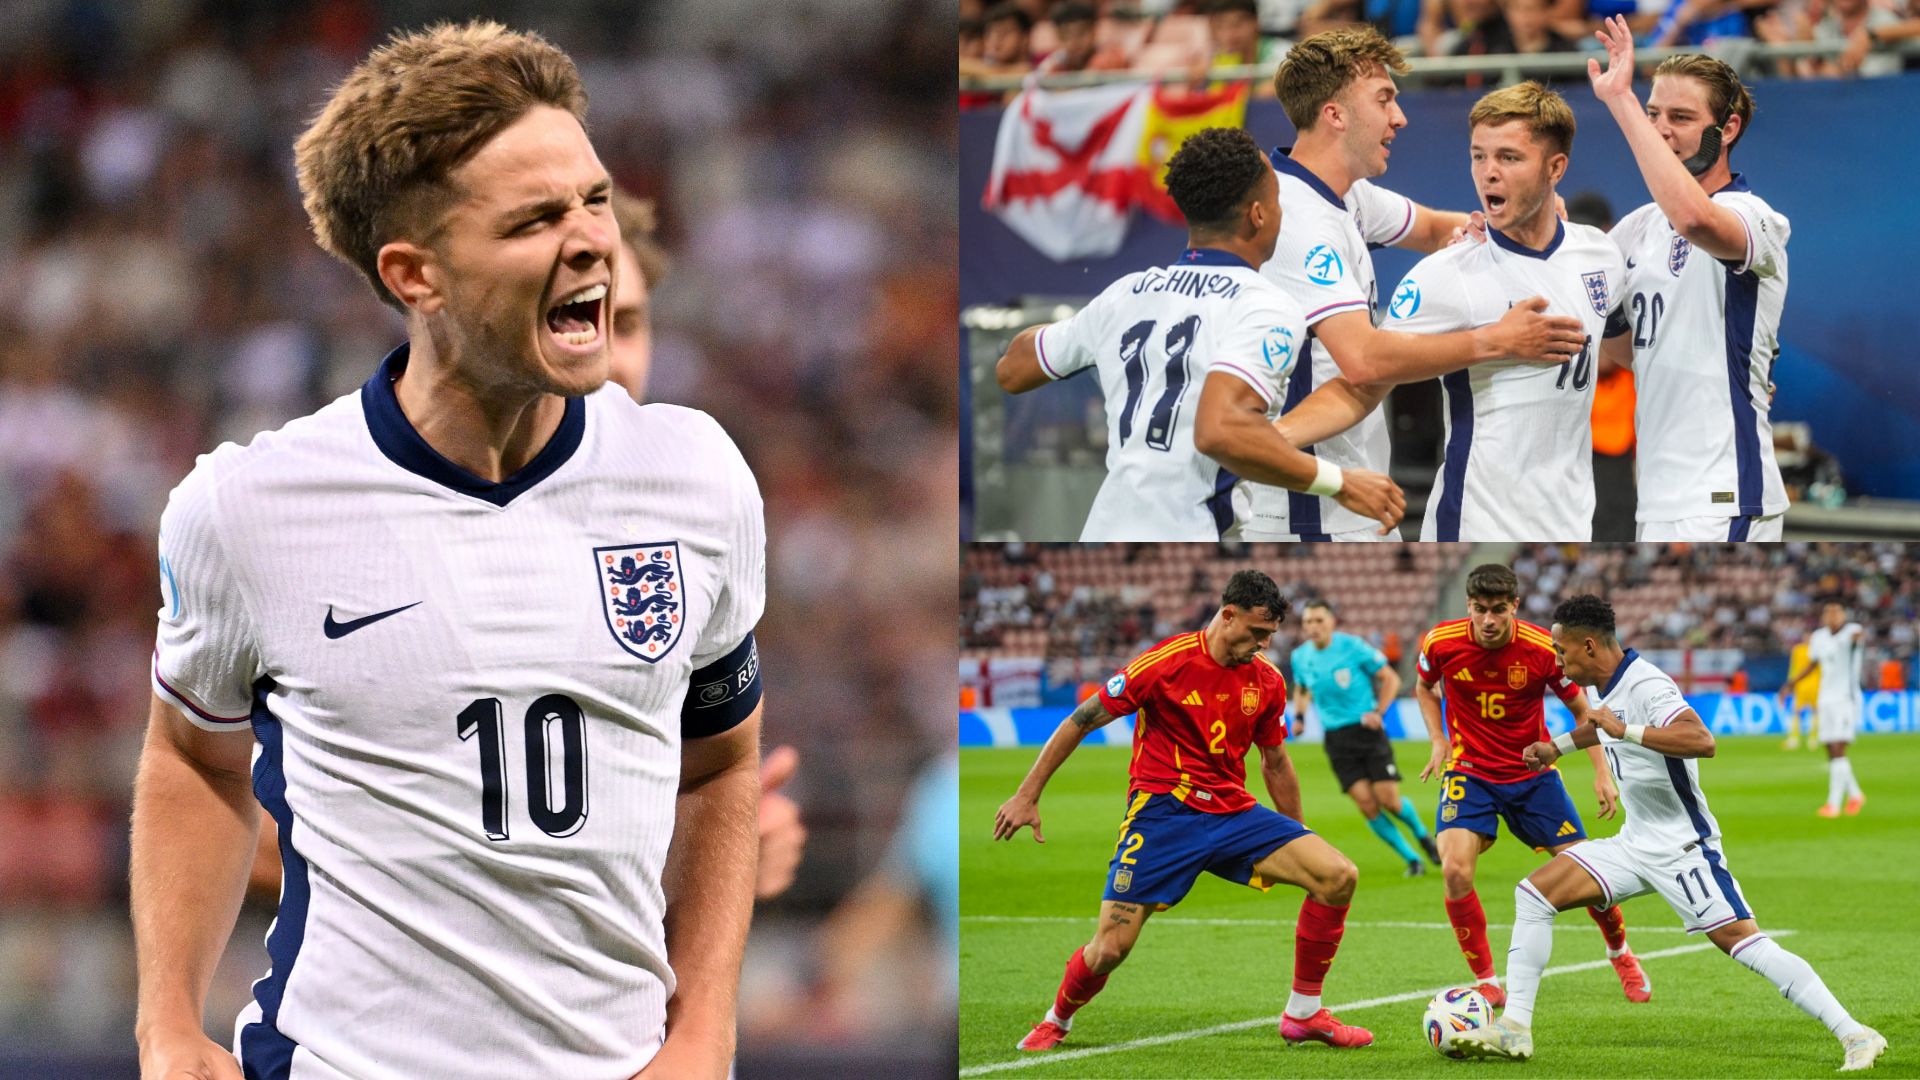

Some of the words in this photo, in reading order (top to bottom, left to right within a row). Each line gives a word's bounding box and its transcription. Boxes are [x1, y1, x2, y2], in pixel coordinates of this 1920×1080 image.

[1632, 291, 1665, 349] 20
[1120, 315, 1202, 452] 11
[1475, 691, 1506, 720] 16
[1209, 719, 1227, 754] 2
[456, 693, 589, 842] 10
[1441, 775, 1467, 802] 16
[1120, 832, 1144, 865] 2
[1676, 867, 1713, 906] 11
